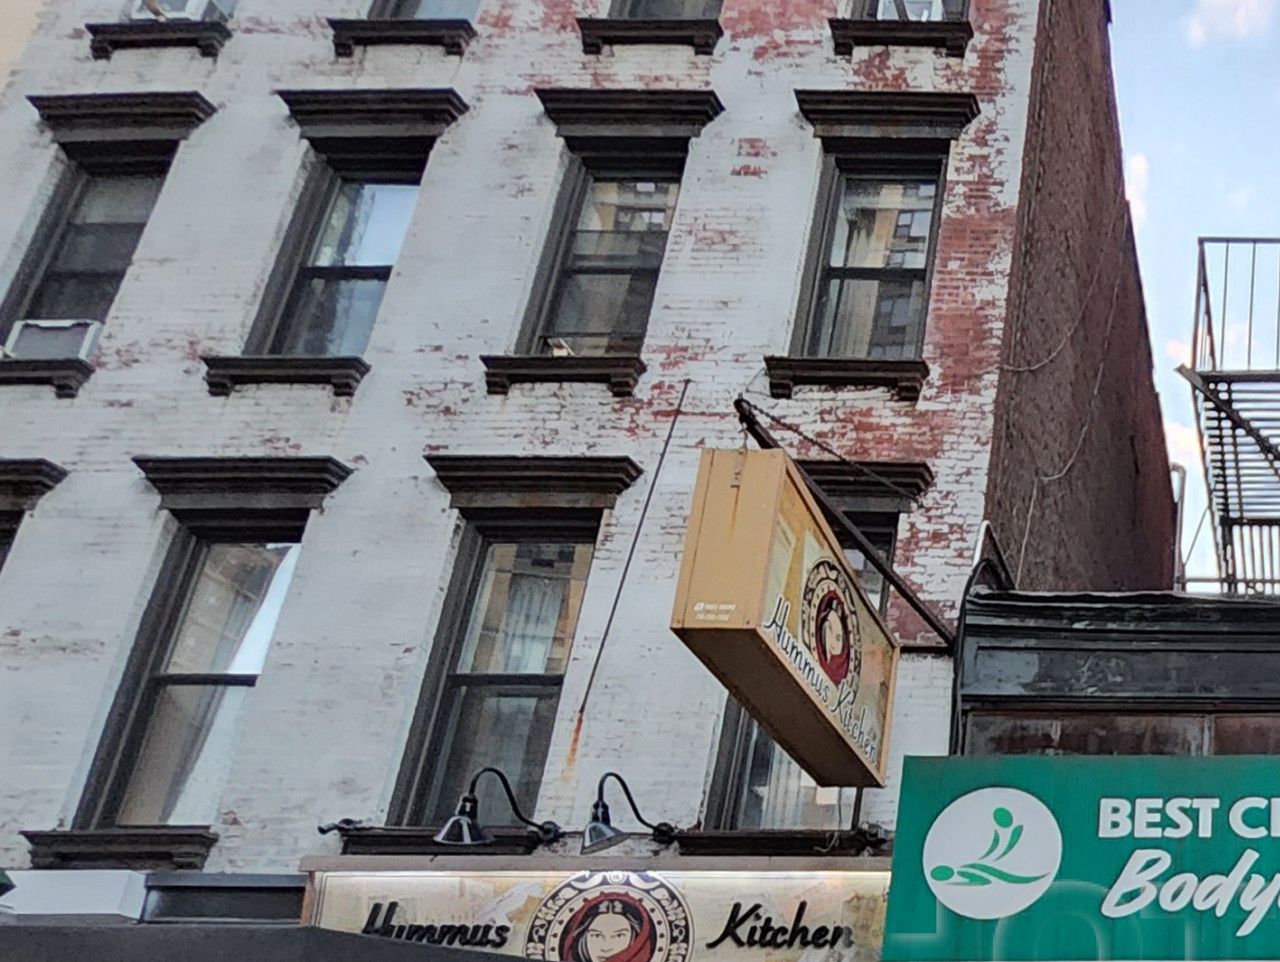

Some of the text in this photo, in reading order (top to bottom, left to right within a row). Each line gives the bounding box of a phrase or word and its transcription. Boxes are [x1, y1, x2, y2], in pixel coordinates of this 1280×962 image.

[764, 597, 877, 764] Hummus Kitchen
[1098, 796, 1220, 838] BEST
[706, 900, 855, 950] Kitchen
